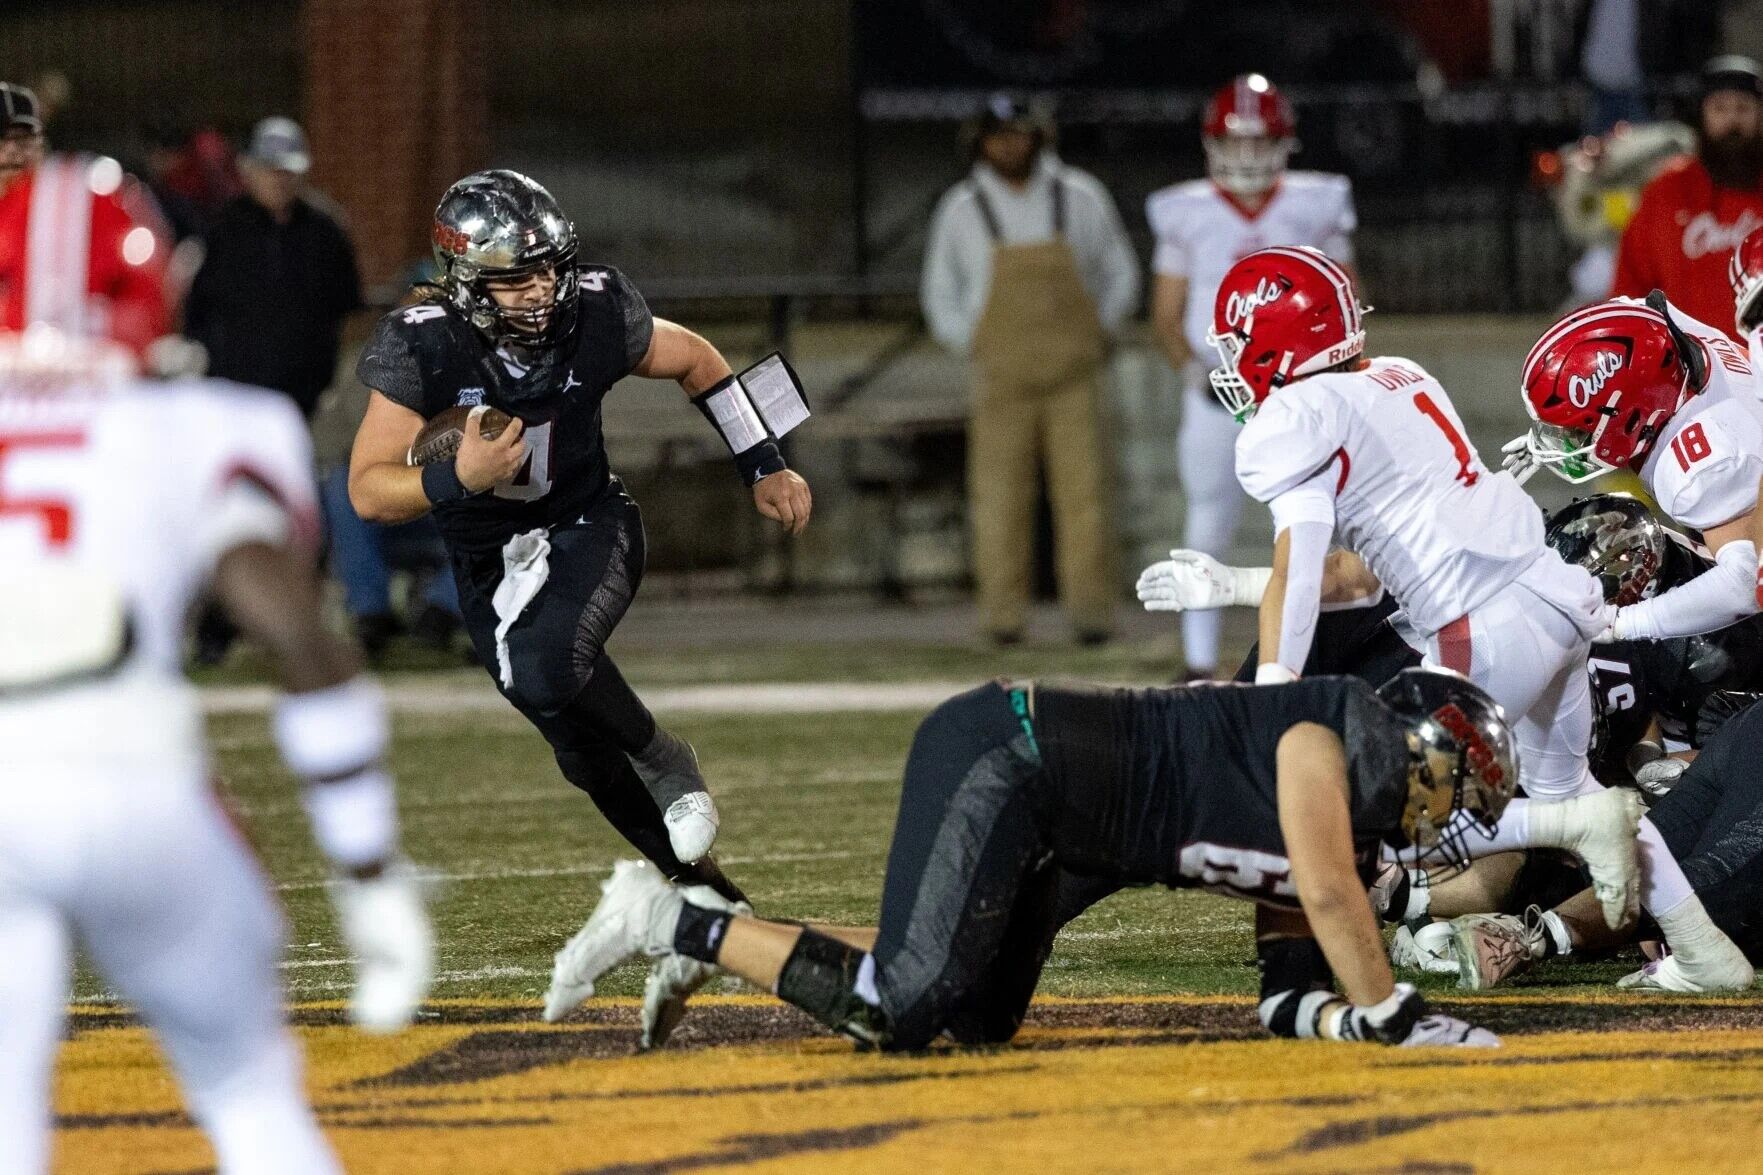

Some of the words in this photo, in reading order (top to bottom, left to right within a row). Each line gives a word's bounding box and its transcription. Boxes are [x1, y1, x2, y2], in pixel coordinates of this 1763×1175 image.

[579, 272, 611, 291] 4
[403, 305, 448, 324] 4
[1568, 351, 1623, 409] Owls
[493, 421, 554, 503] 4
[1413, 391, 1480, 488] 1
[1670, 422, 1712, 474] 18
